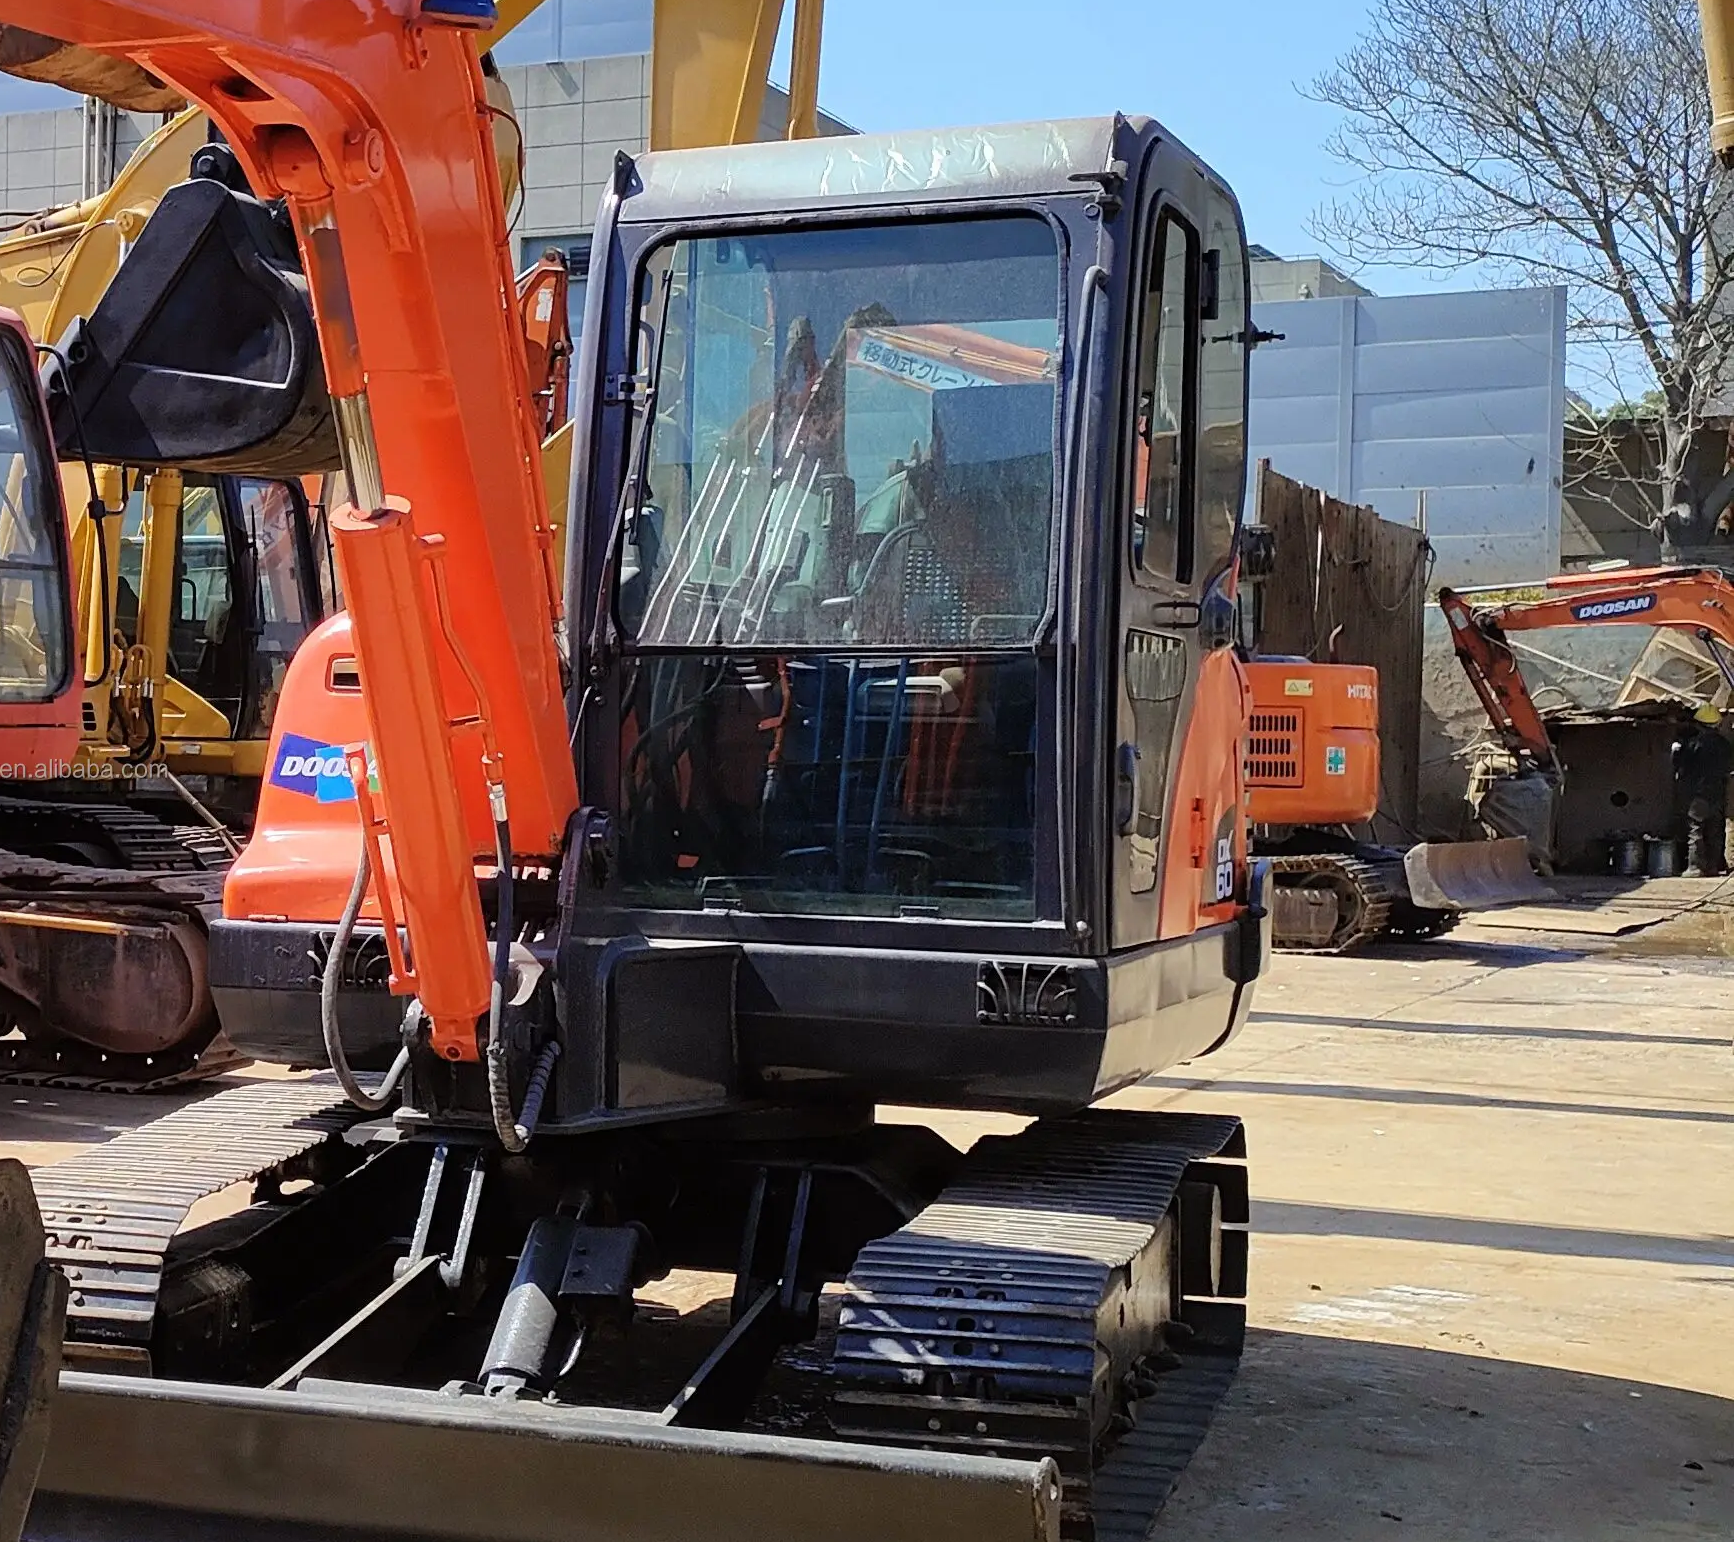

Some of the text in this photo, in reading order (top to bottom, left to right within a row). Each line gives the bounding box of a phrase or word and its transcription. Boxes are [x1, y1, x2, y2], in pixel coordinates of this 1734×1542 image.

[1579, 597, 1650, 619] DOOSAN
[280, 756, 378, 778] DOOA
[1216, 861, 1233, 900] 60
